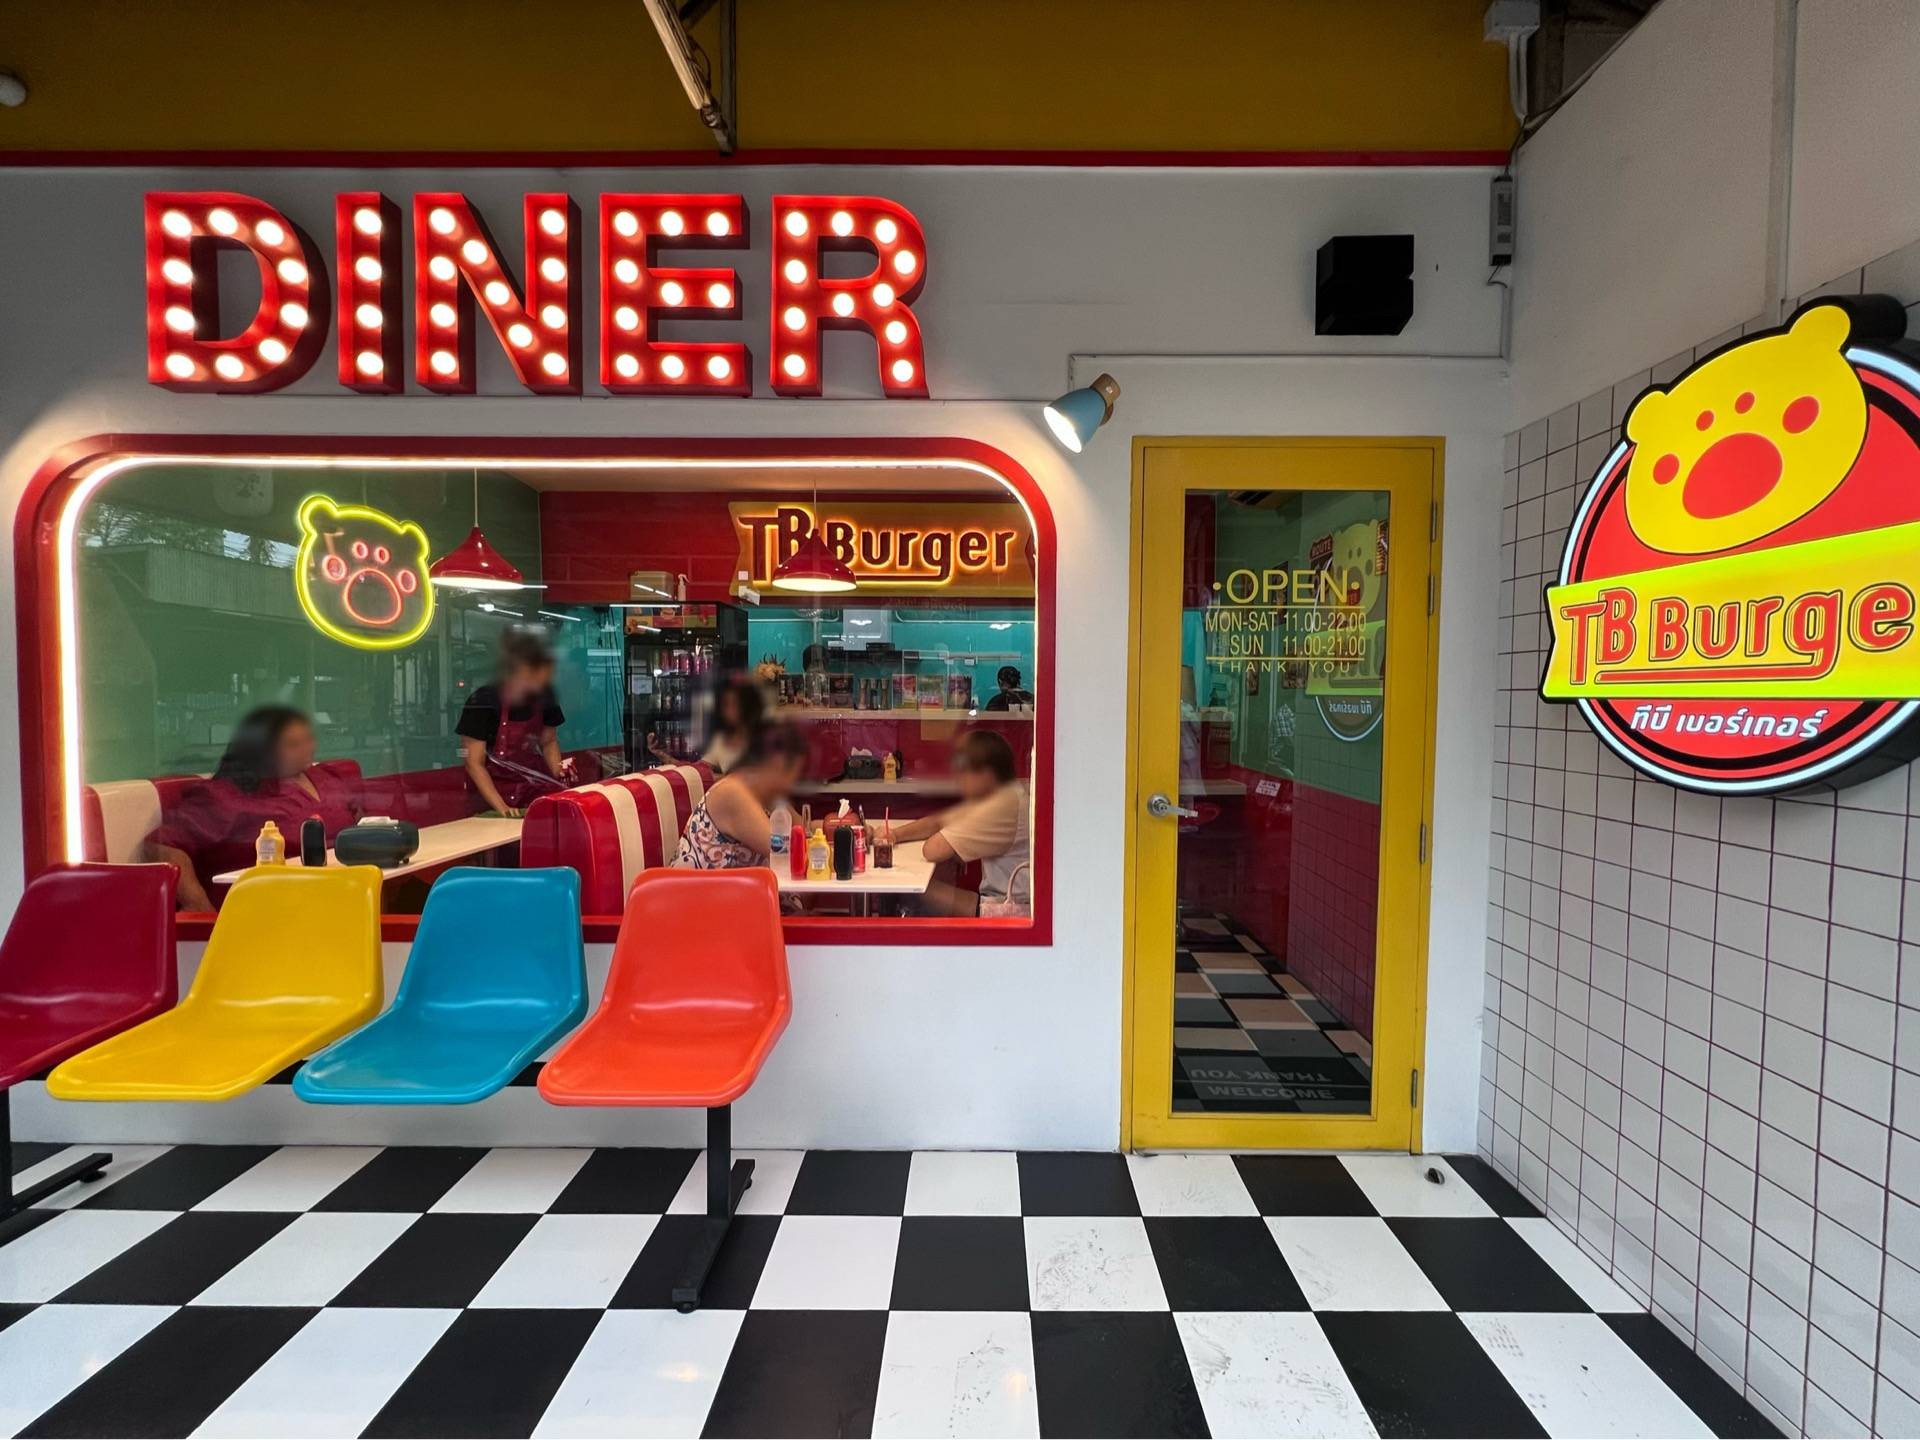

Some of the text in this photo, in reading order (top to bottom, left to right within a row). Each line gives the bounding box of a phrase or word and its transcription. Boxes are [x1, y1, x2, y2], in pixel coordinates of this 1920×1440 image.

[144, 190, 930, 398] DINER
[824, 520, 1016, 584] Burger
[1226, 569, 1348, 604] OPEN
[1205, 612, 1367, 633] MON-SAT 11.00-22.00
[1561, 587, 1637, 685] TB
[1230, 635, 1264, 655] SUN
[1283, 635, 1366, 656] 11.00-21.00
[1218, 661, 1351, 673] THANK YOU
[1631, 704, 1829, 739] ทีบี เบอร์เกอร์
[1191, 1069, 1333, 1083] THANK YOU
[1208, 1085, 1336, 1100] WELCOME
